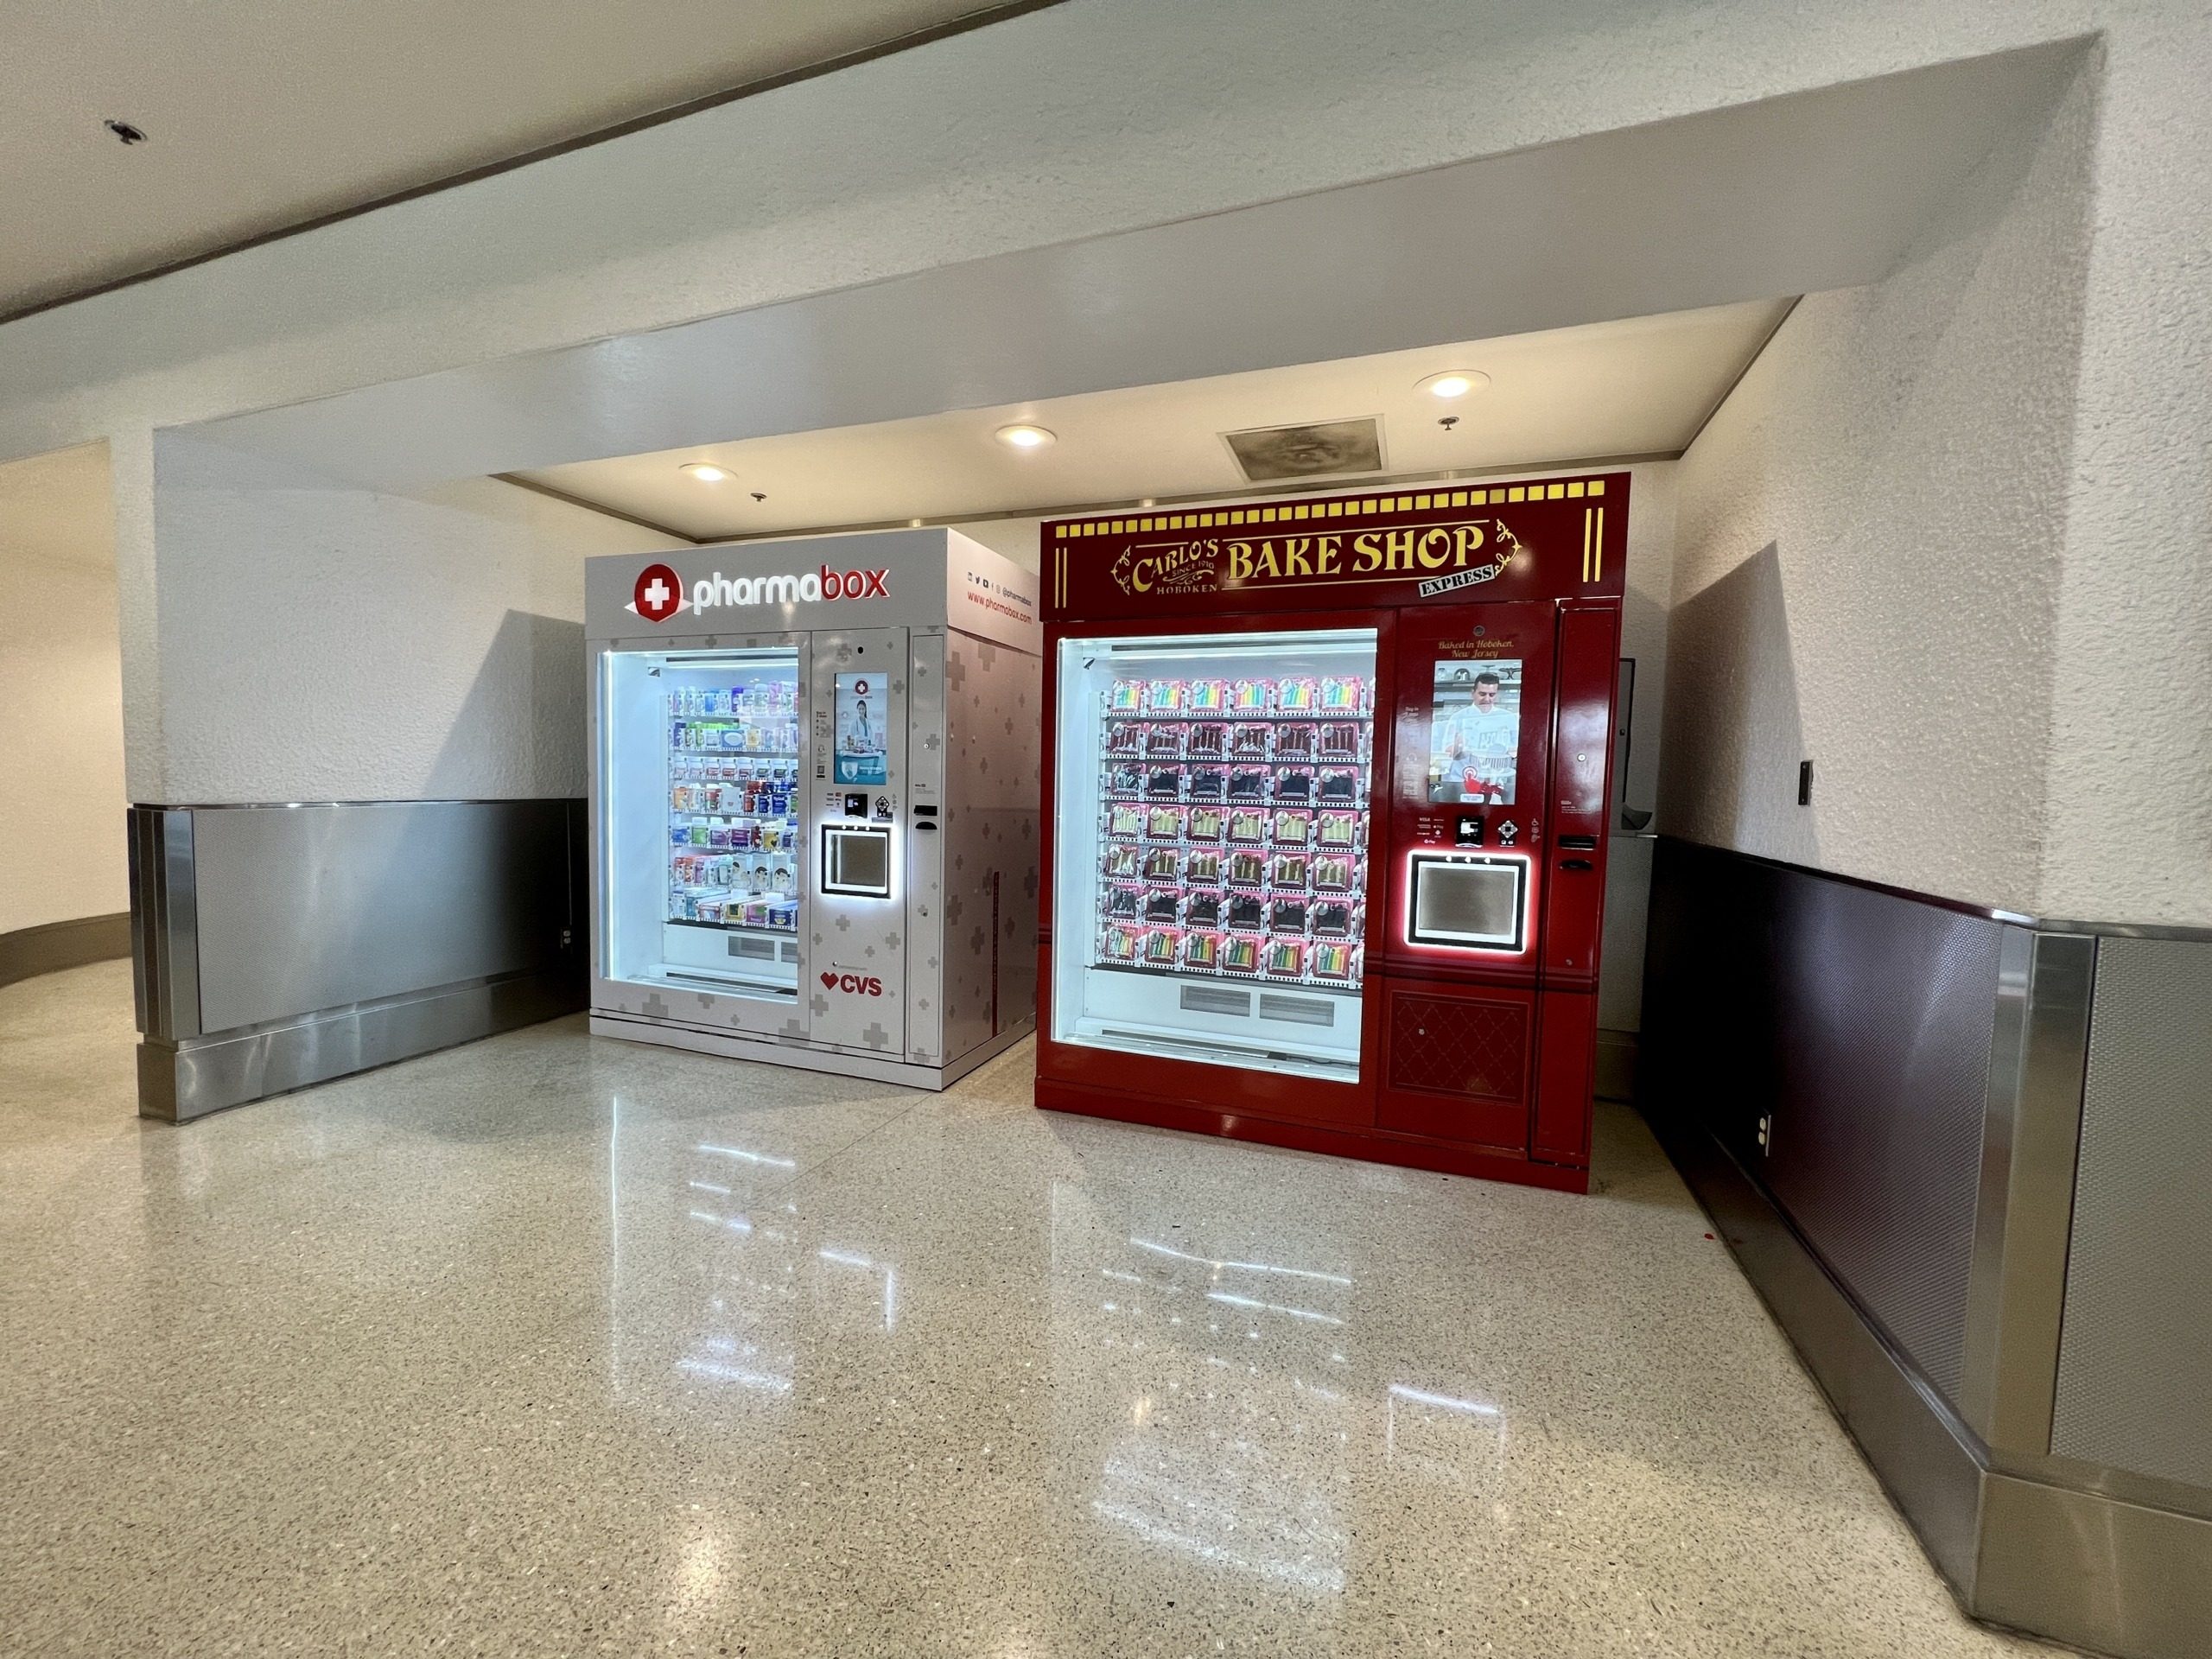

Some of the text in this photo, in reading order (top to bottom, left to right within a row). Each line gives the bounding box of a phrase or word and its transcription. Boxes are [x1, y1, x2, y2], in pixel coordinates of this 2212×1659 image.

[1133, 538, 1219, 593] CARLO'S
[1226, 525, 1484, 581] BAKE SHOP
[1172, 560, 1215, 577] SINCE 1910
[1421, 566, 1494, 597] EXPRESS
[693, 564, 891, 616] pharmabox
[1157, 584, 1217, 595] HOBOKEN
[967, 590, 1033, 625] www.pharmabox.com
[1438, 640, 1465, 650] Baked
[1466, 640, 1475, 649] in
[1471, 649, 1499, 659] Jersey
[840, 974, 883, 997] CVS
